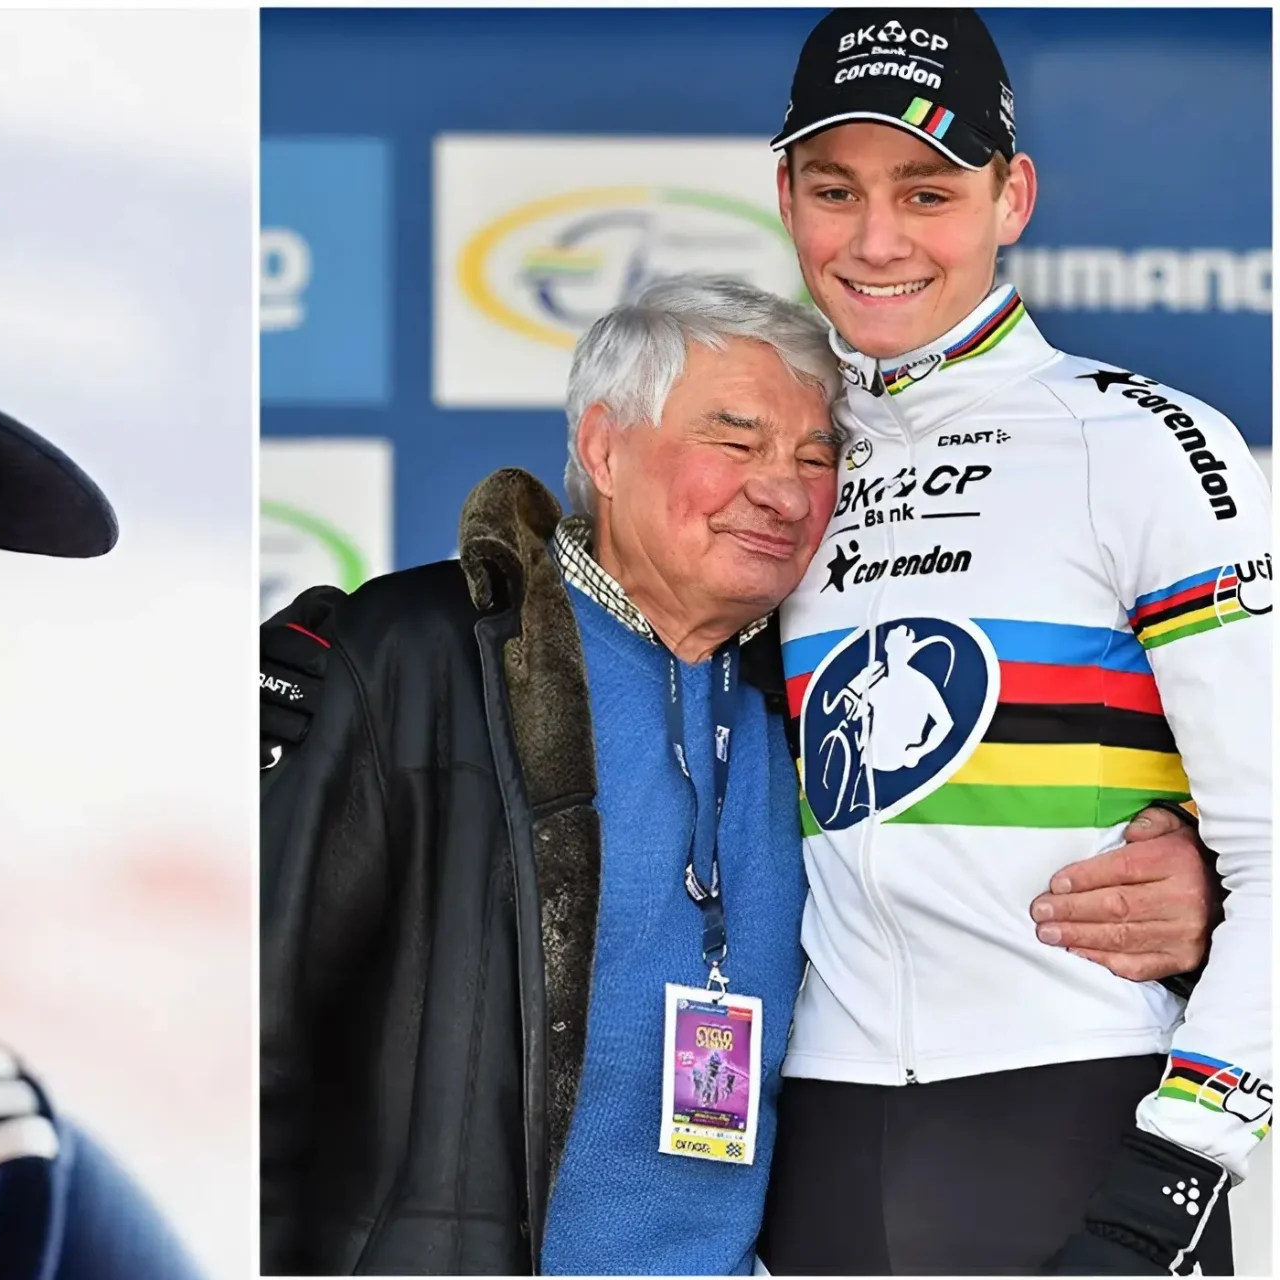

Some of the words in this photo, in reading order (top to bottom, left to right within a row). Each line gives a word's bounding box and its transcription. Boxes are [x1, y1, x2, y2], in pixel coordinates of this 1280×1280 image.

[834, 61, 942, 90] corendon
[937, 431, 994, 447] CRAFT
[1121, 387, 1238, 520] corendon
